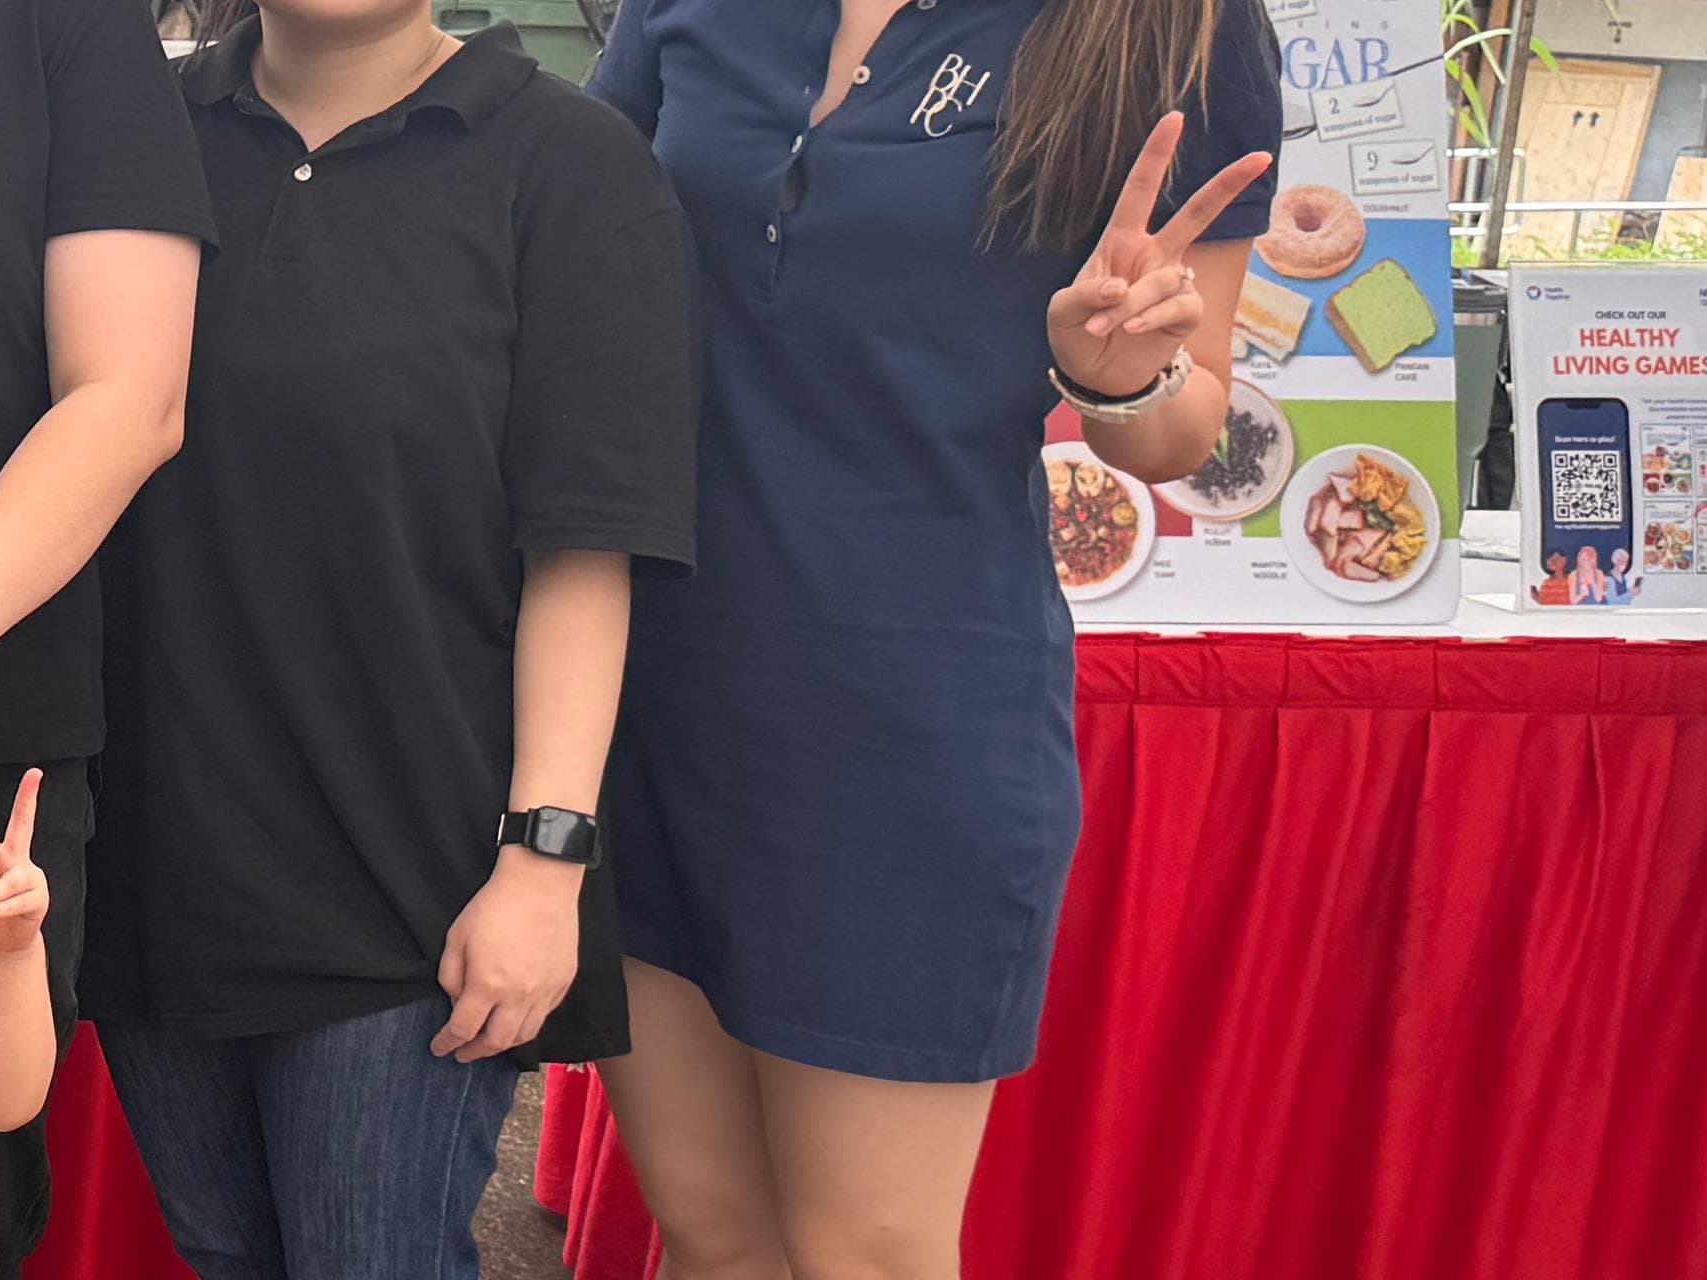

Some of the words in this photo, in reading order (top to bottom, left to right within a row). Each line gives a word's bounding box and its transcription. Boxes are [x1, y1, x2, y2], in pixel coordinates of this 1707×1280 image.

[1328, 97, 1341, 115] 2
[1367, 150, 1379, 171] 9
[1580, 327, 1681, 348] HEALTHY
[1553, 355, 1629, 376] LIVING
